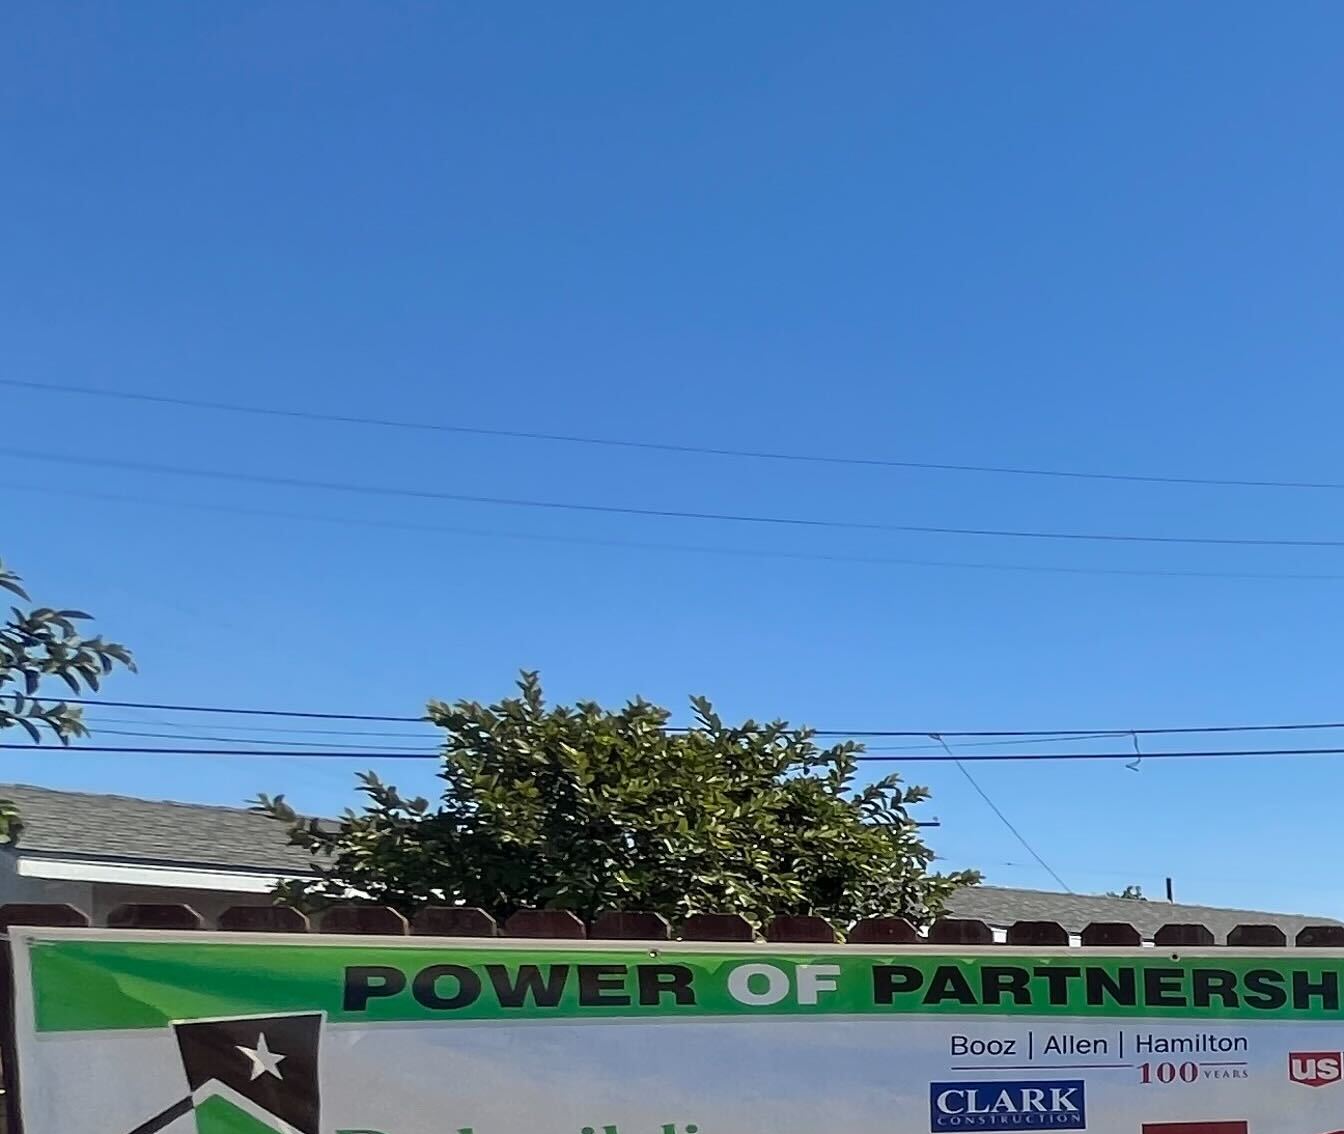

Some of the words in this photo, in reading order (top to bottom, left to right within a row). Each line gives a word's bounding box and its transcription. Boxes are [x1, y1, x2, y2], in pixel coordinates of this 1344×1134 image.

[343, 964, 697, 1011] POWER
[727, 963, 841, 1007] OF
[951, 1036, 1017, 1056] Booz
[1043, 1034, 1108, 1055] Allen
[1136, 1033, 1248, 1054] Hamilton
[1139, 1061, 1199, 1085] 100
[1204, 1069, 1248, 1079] YEARS
[936, 1087, 1080, 1114] CLARK
[936, 1113, 1081, 1126] CONSTRUCTION
